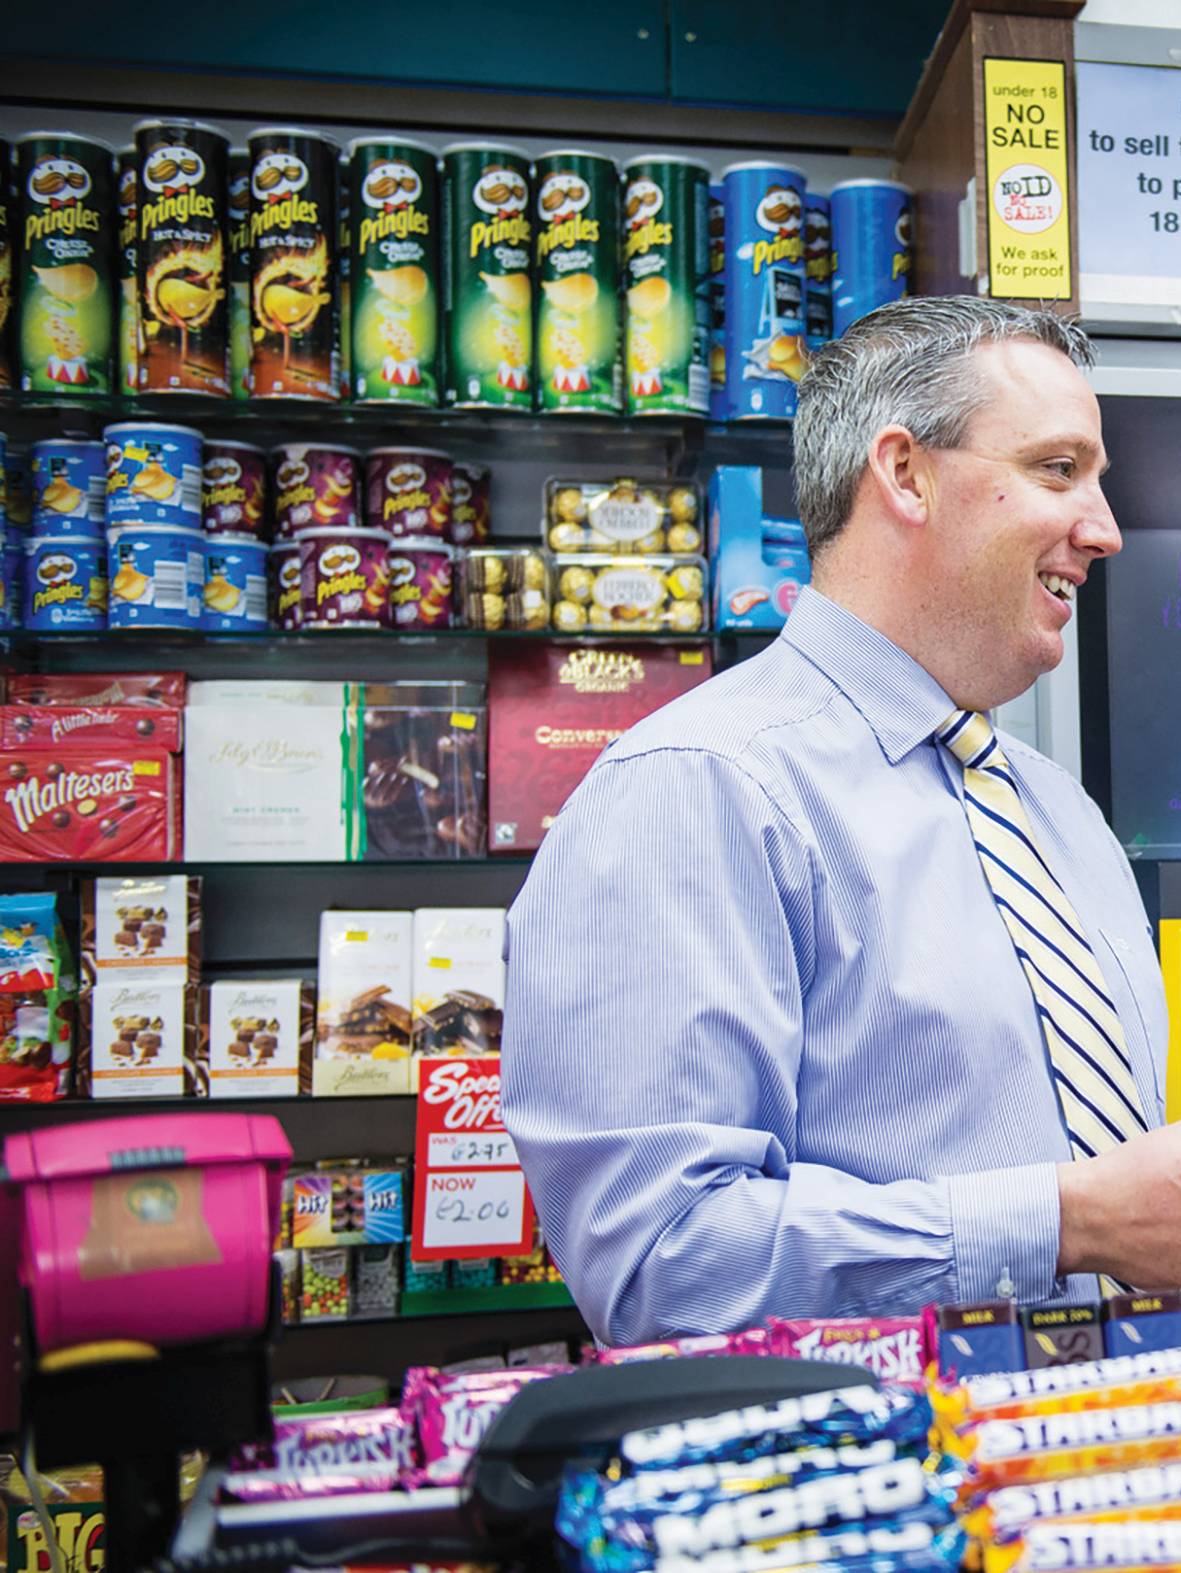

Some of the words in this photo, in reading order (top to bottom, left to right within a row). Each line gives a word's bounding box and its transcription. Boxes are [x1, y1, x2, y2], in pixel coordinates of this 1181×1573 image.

[992, 84, 1035, 98] under
[1042, 86, 1059, 99] 18
[1006, 103, 1046, 125] NO
[991, 126, 1060, 150] SALE
[1088, 129, 1116, 153] to
[1123, 134, 1170, 157] sell
[1136, 172, 1163, 195] to
[140, 187, 215, 241] Pringles
[1149, 210, 1180, 234] 18
[25, 201, 100, 251] Pringles
[359, 205, 430, 255] Pringles
[1002, 245, 1026, 260] We
[1030, 247, 1058, 261] ask
[996, 262, 1018, 277] for
[1022, 264, 1065, 279] proof
[5, 769, 136, 833] Maltesers
[432, 1177, 476, 1192] NOW
[961, 1310, 995, 1324] MILK
[1131, 1298, 1162, 1313] MILK
